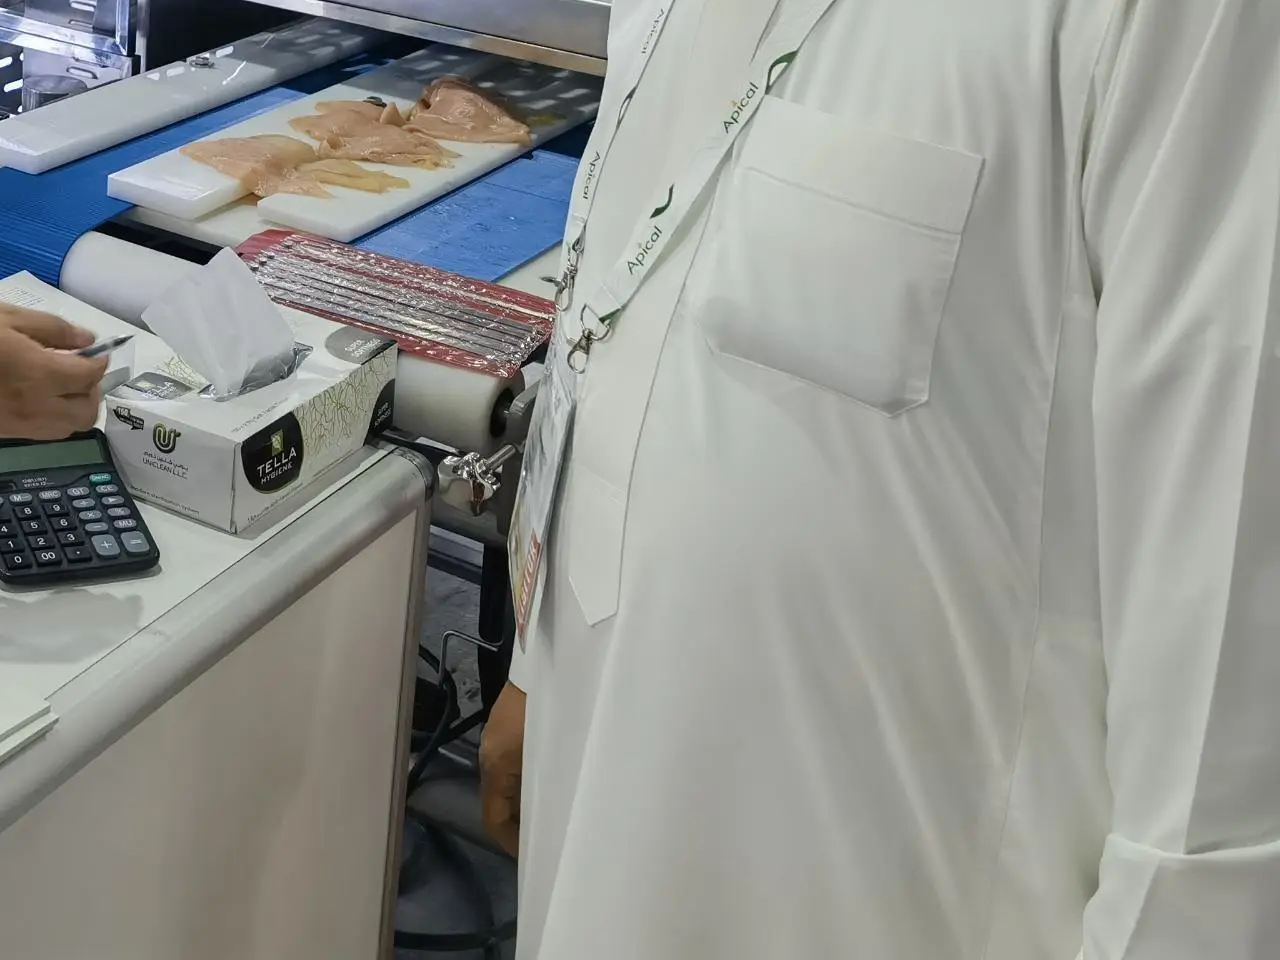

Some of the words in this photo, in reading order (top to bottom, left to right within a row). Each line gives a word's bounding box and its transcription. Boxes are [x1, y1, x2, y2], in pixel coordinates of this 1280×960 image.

[723, 81, 759, 134] Apical
[582, 151, 601, 200] Apical
[626, 225, 663, 276] Apical
[257, 446, 297, 478] TELLA
[260, 462, 294, 485] HYGIENE
[24, 507, 32, 515] 8
[52, 504, 60, 512] 9
[0, 525, 8, 533] 4
[30, 521, 39, 529] 5
[60, 518, 68, 526] 6
[37, 537, 46, 546] 2
[66, 533, 75, 541] 3
[14, 555, 22, 564] 0
[41, 552, 56, 560] 00
